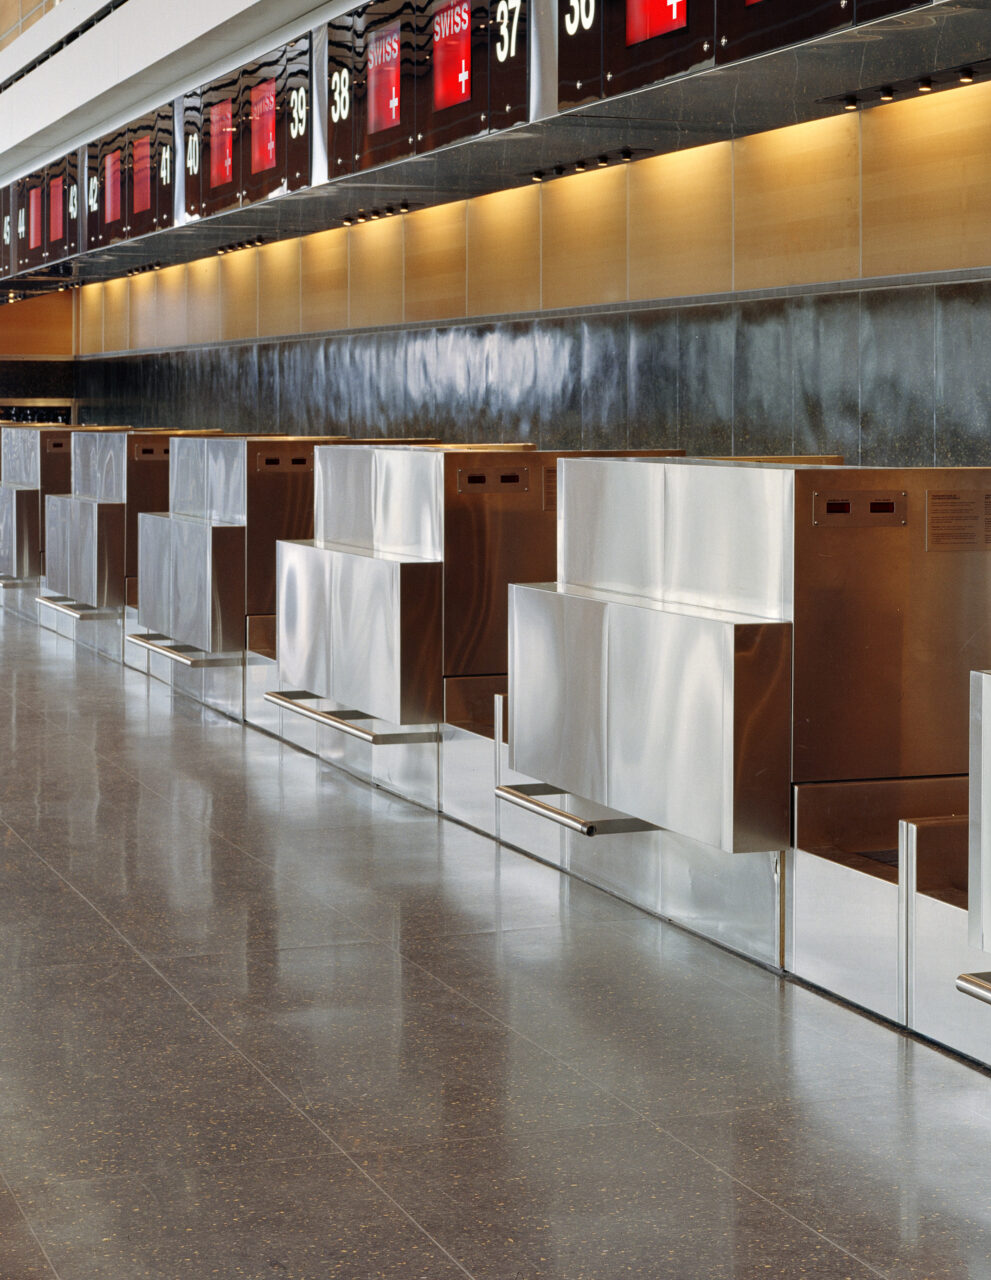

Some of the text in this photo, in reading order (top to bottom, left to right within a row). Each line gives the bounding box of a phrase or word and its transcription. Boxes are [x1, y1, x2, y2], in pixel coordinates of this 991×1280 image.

[434, 0, 469, 42] swiss
[367, 31, 399, 70] swiss
[290, 86, 307, 139] 39
[331, 68, 350, 123] 38
[160, 144, 171, 186] 41
[186, 132, 199, 176] 40
[68, 184, 78, 219] 43
[88, 175, 98, 212] 42
